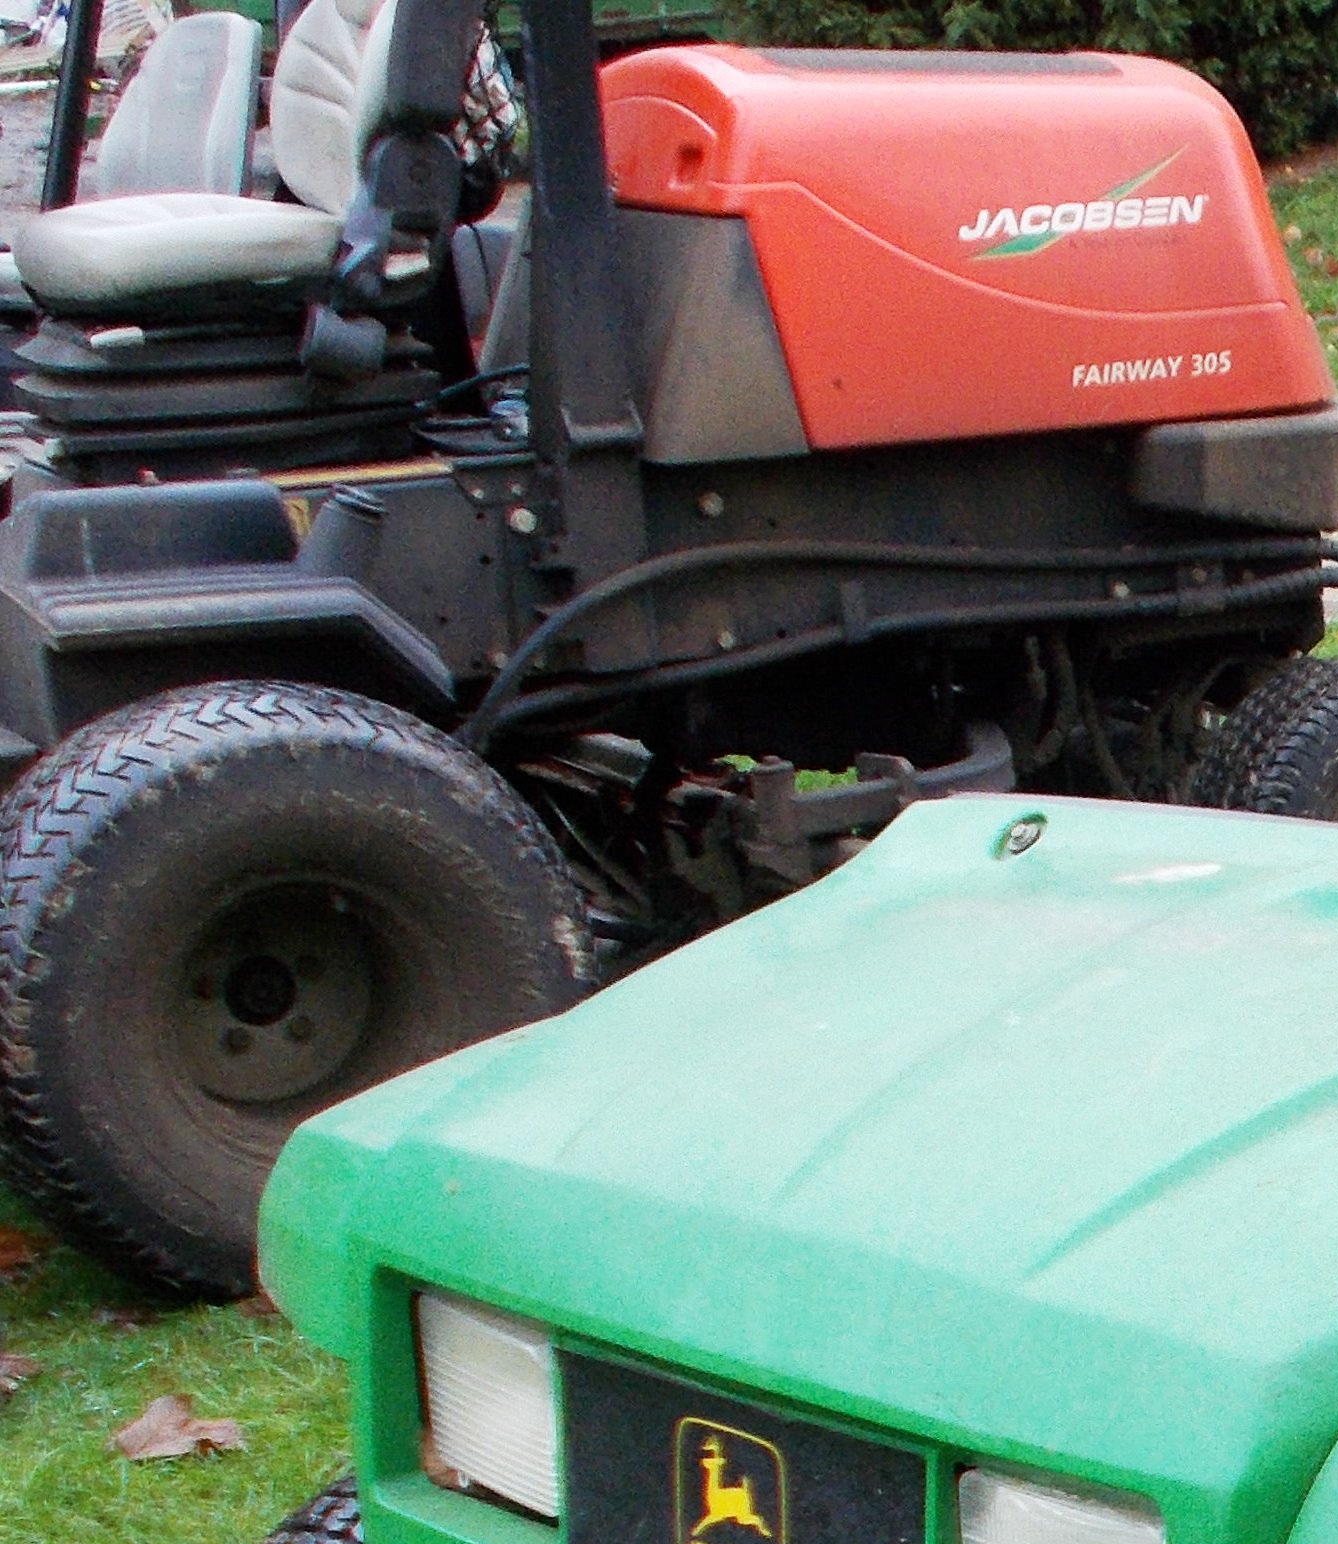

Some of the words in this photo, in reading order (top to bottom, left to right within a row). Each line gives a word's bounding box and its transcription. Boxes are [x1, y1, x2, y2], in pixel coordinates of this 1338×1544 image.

[958, 194, 1210, 242] JACOBSEN
[1072, 356, 1183, 388] FAIRWAY
[1190, 351, 1232, 376] 305
